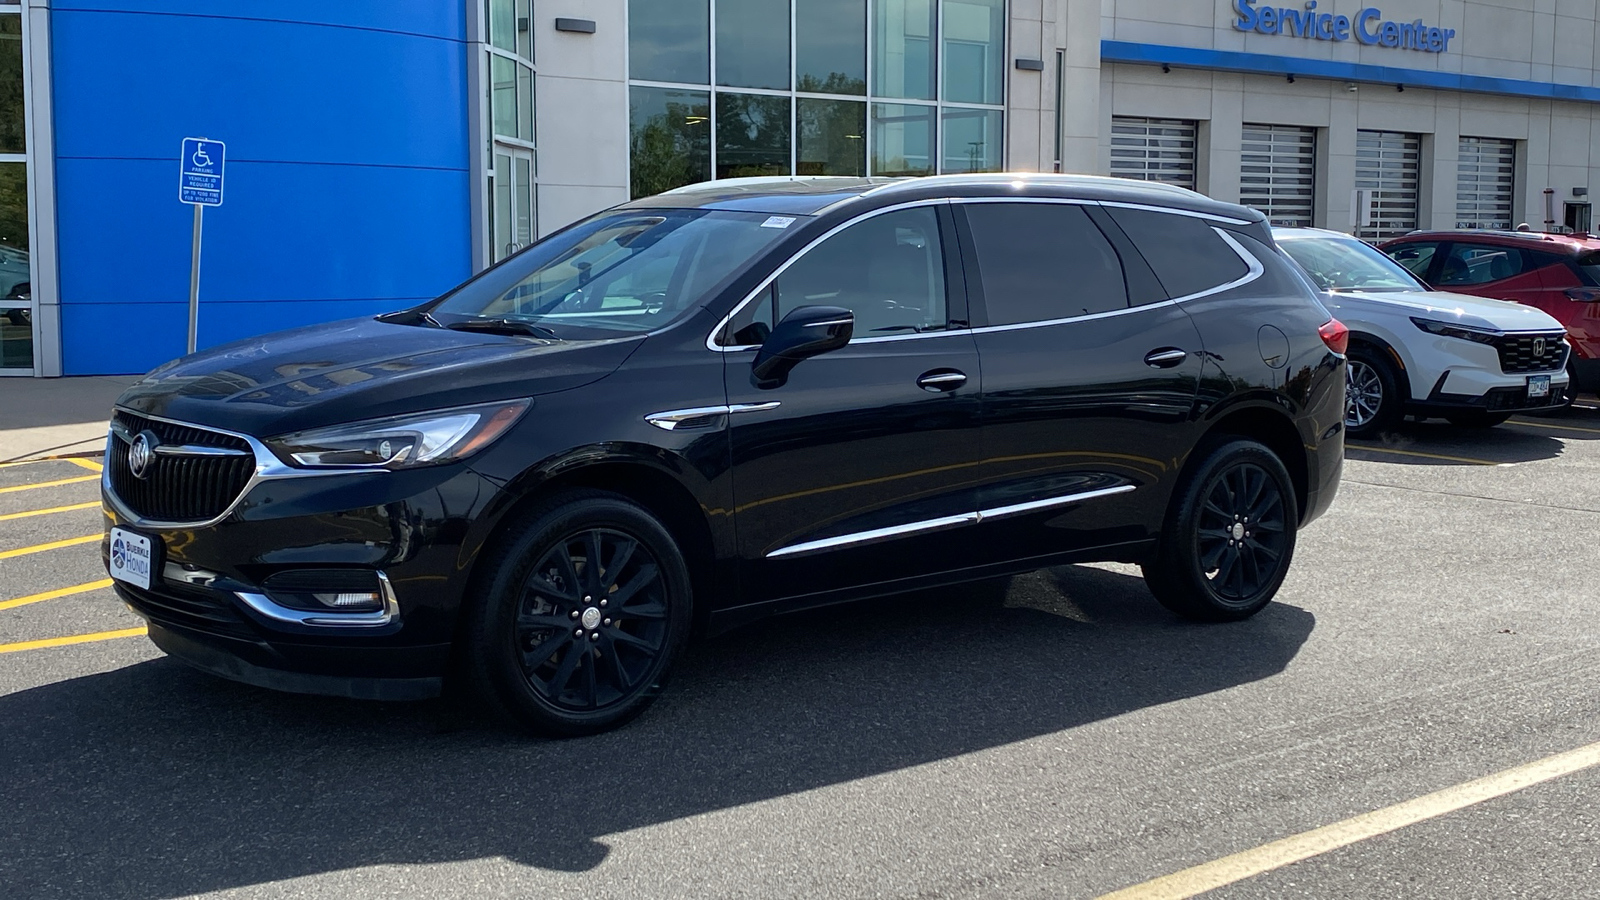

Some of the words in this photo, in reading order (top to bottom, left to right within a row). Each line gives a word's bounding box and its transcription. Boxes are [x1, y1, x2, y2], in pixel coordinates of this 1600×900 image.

[1232, 0, 1350, 41] Service
[1354, 7, 1455, 52] Center
[189, 181, 215, 189] REQUIRED
[126, 541, 149, 559] BUERKLE
[126, 552, 149, 574] HONDA
